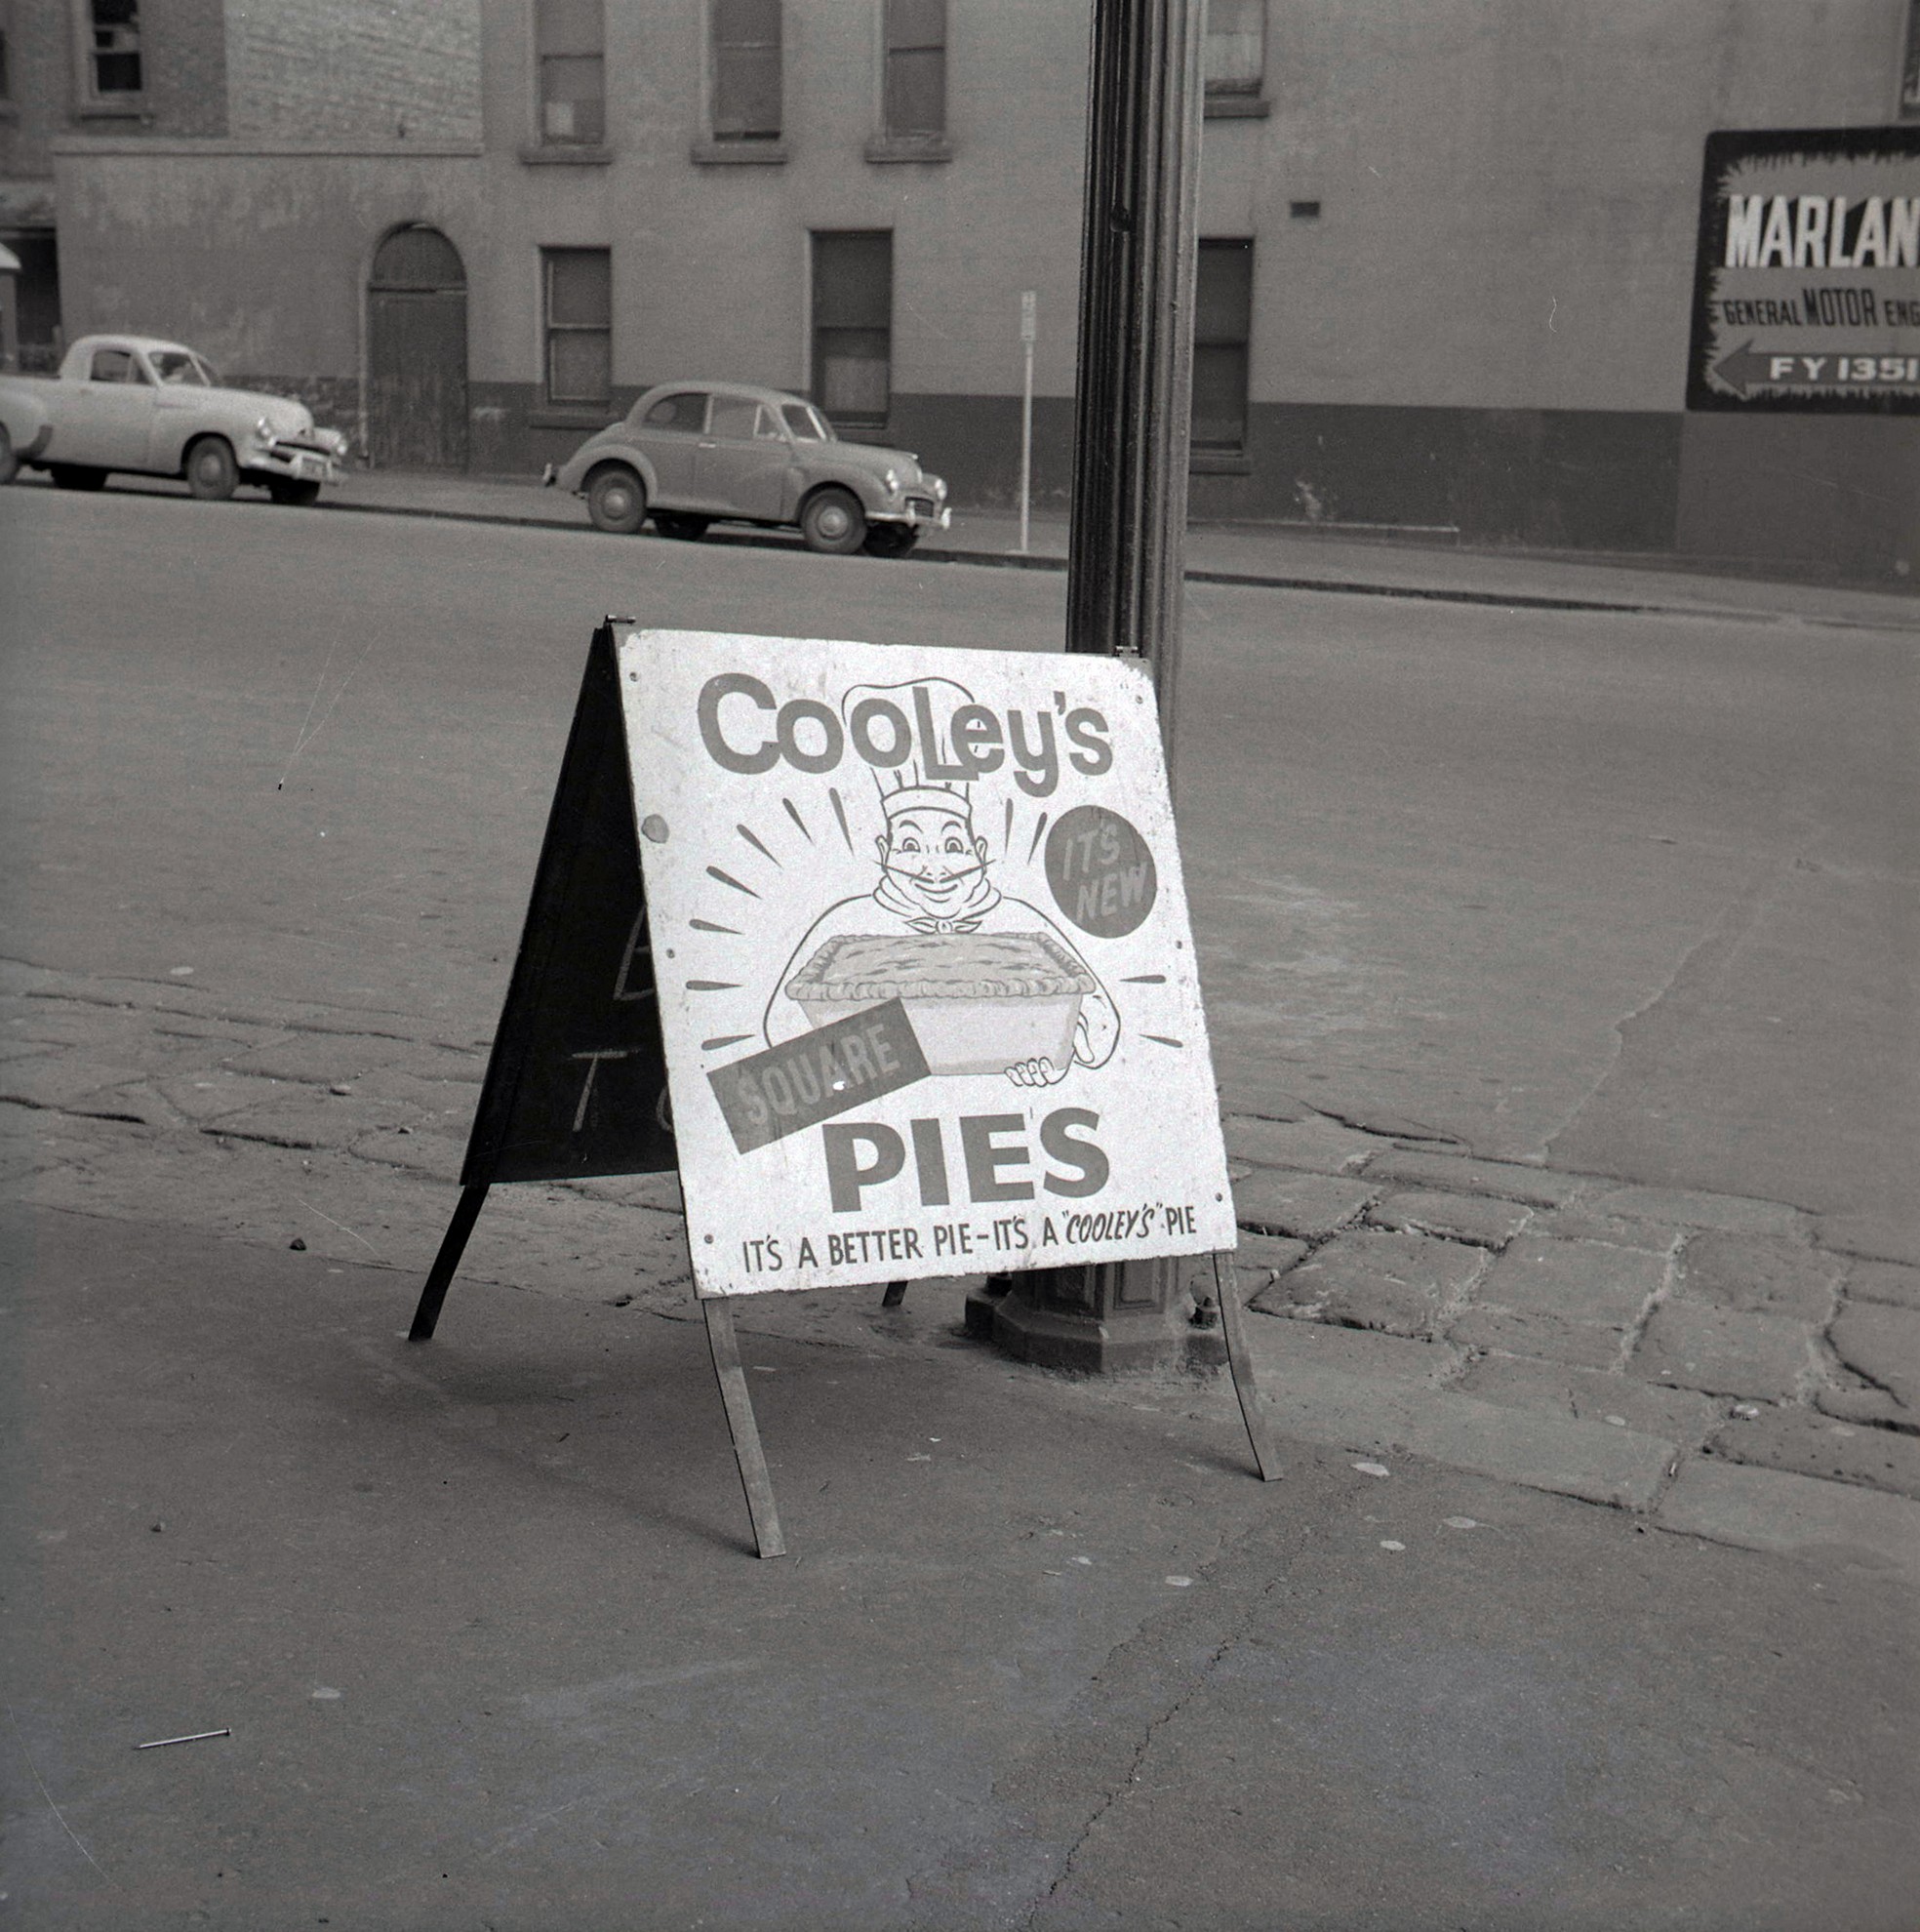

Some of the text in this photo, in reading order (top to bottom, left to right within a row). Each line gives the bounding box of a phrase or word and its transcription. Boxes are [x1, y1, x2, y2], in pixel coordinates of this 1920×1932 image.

[1724, 195, 1920, 268] MARLAN
[1723, 300, 1801, 325] GENERAL
[1802, 287, 1878, 327] MOTOR
[1075, 861, 1149, 922] NEW
[737, 1024, 901, 1124] SQUARE
[742, 1234, 783, 1273] IT'S
[798, 1236, 820, 1269] A
[827, 1228, 924, 1267] BETTER
[1042, 1216, 1060, 1247] A
[1165, 1205, 1198, 1236] PIE
